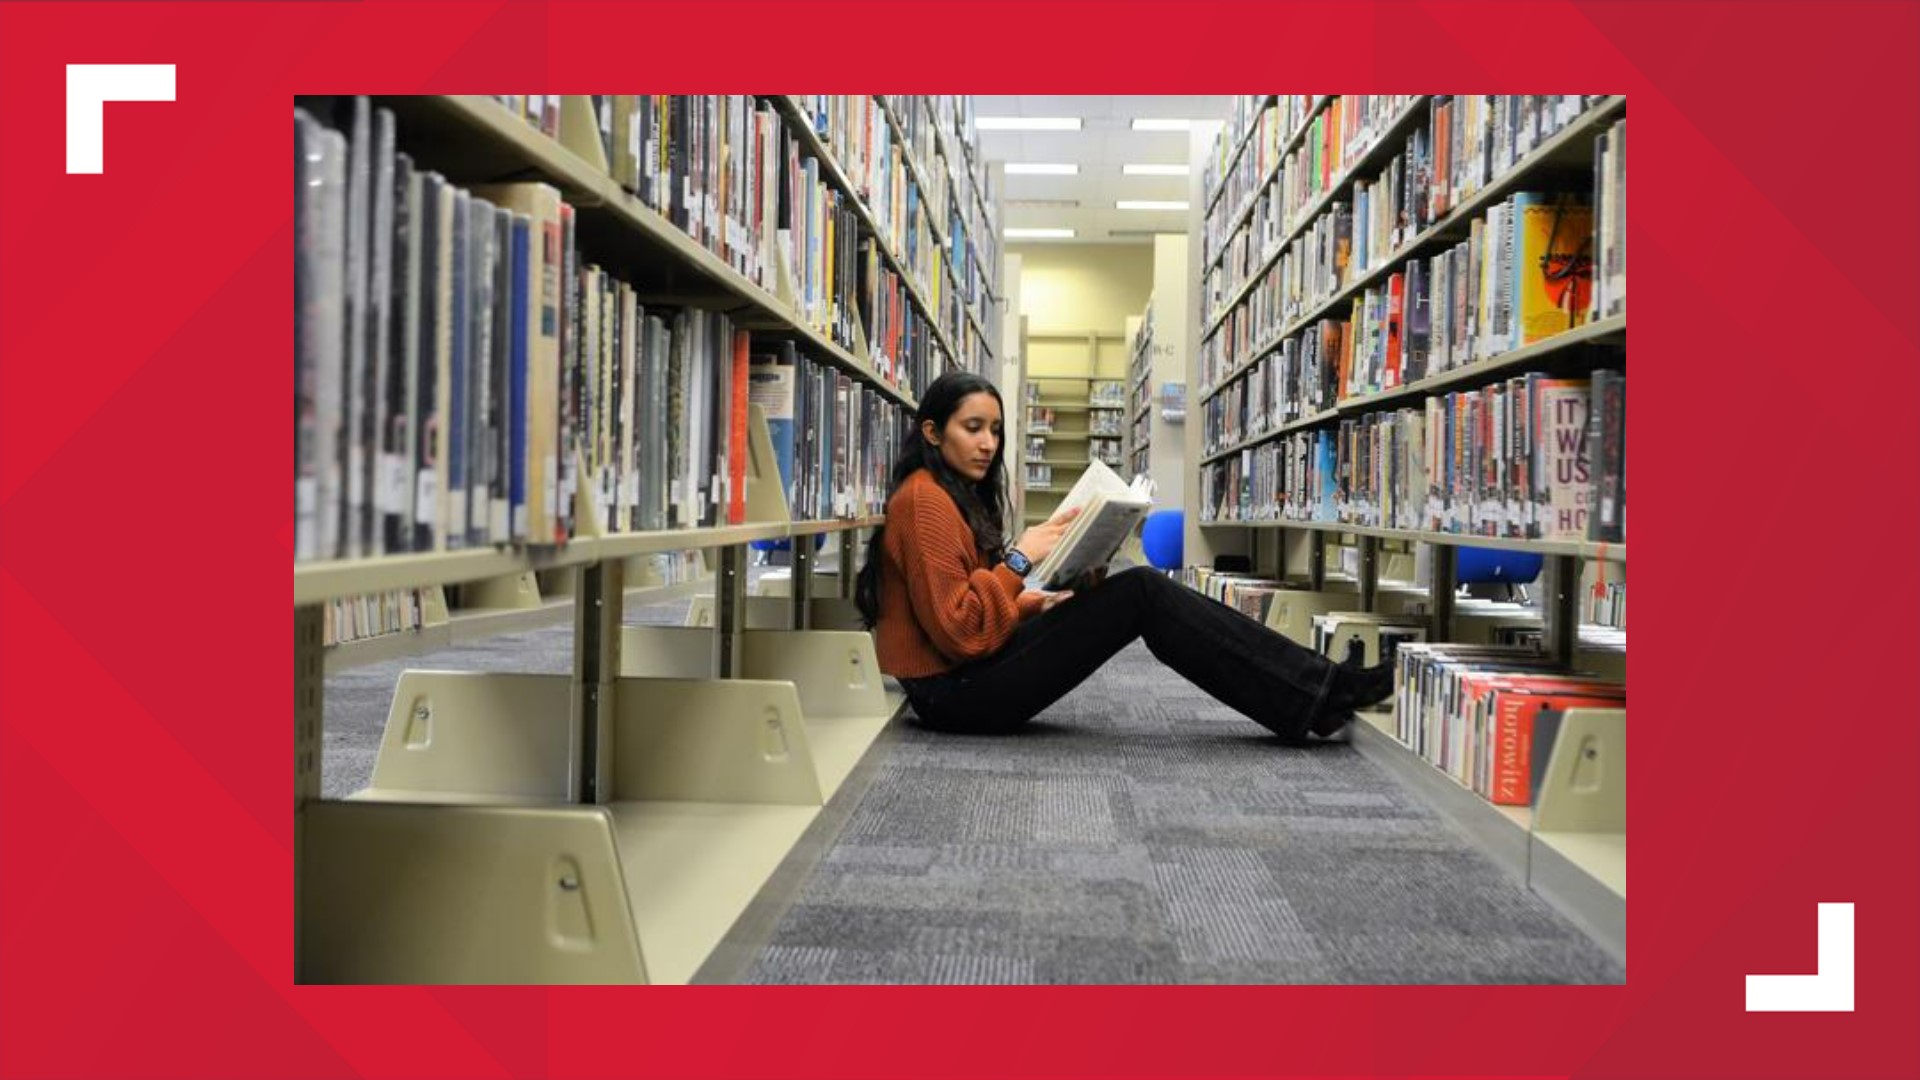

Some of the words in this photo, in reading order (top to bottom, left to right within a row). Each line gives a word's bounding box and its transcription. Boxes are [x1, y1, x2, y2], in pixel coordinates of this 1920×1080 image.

[1557, 399, 1578, 424] IT
[1557, 458, 1590, 483] US
[1502, 700, 1526, 798] horowitz
